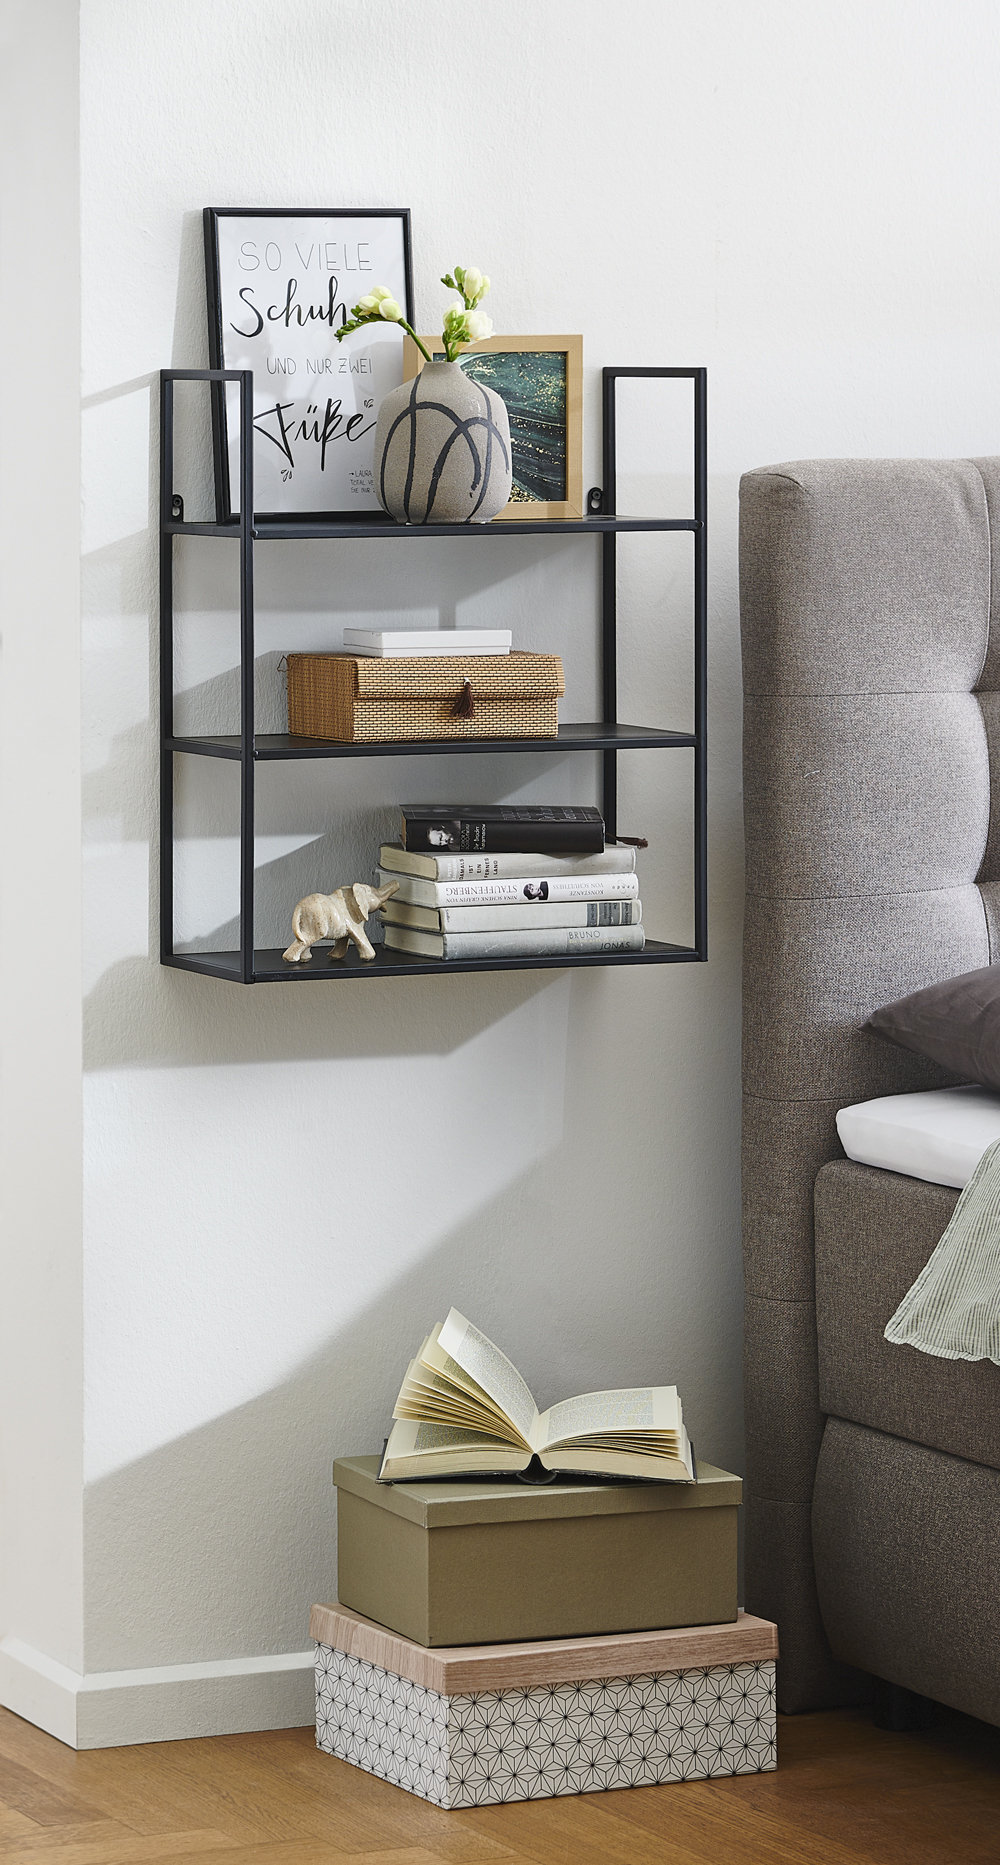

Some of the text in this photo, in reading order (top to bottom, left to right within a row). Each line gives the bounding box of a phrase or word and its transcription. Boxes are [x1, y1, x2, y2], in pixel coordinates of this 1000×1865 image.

[238, 241, 373, 271] SO VIELE
[230, 275, 347, 338] Schuh
[266, 357, 372, 375] UND NUR ZWEI
[253, 398, 377, 472] Füße
[446, 885, 517, 895] STAUFFENBERG
[569, 931, 600, 939] BRUNO
[600, 942, 630, 950] JONAS
